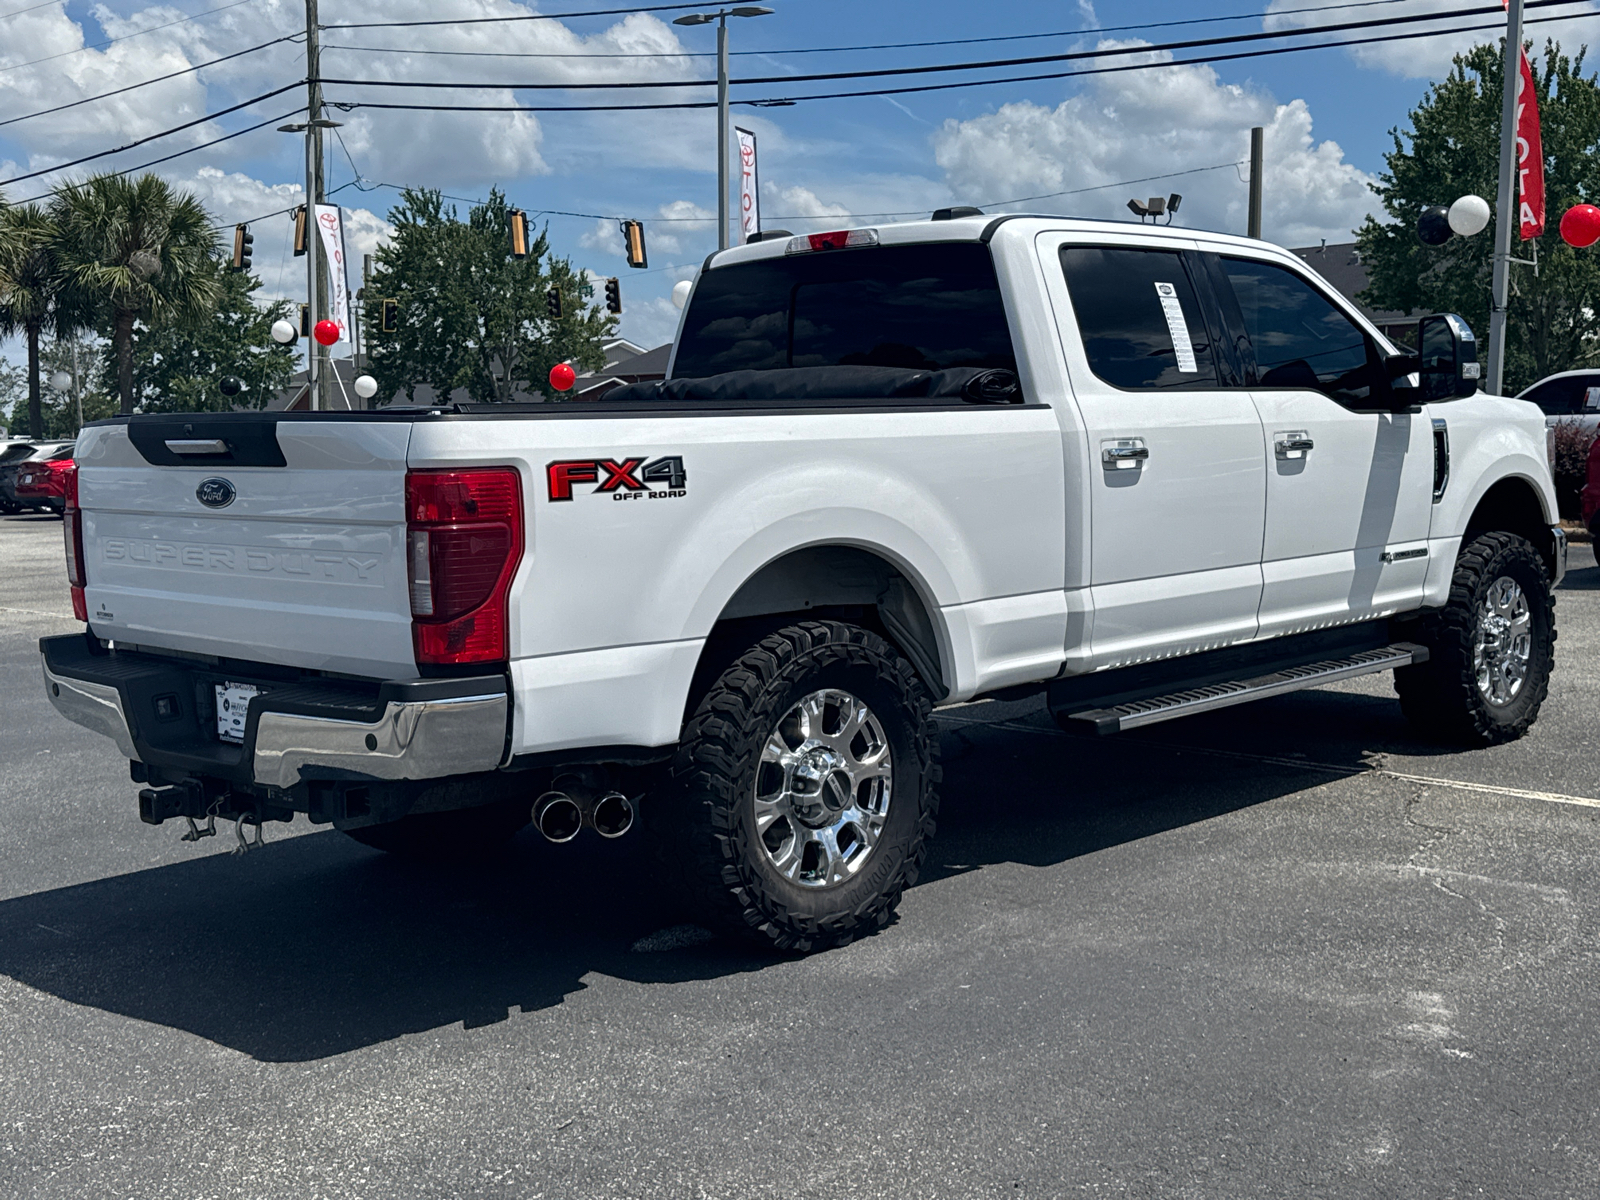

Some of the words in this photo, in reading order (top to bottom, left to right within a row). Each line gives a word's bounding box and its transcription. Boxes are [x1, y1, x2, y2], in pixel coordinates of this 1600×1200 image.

[545, 455, 687, 503] FX4
[613, 492, 643, 501] OFF
[648, 490, 687, 500] ROAD
[105, 540, 235, 570] SUPER
[246, 552, 379, 580] DUTY
